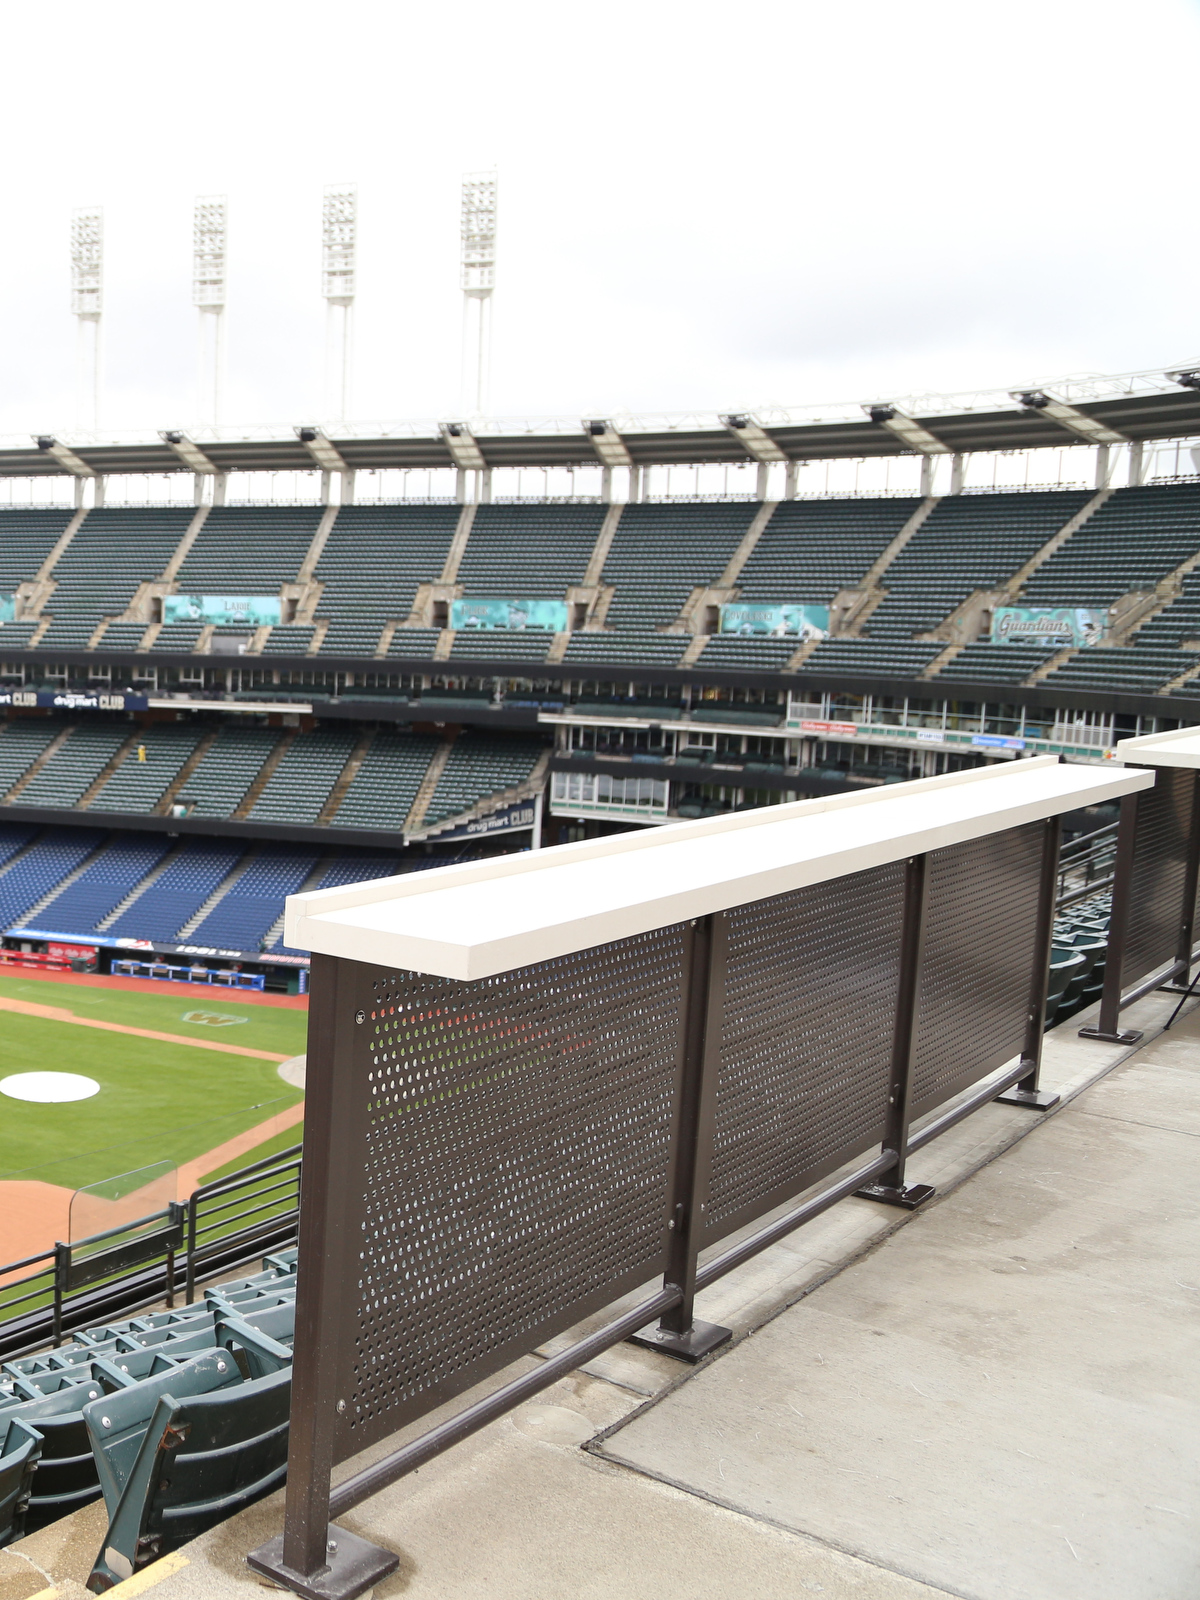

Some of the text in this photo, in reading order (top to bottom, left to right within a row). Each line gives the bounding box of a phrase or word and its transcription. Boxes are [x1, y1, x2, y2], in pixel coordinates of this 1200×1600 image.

[1000, 613, 1072, 636] Guardians
[12, 692, 37, 707] CLUB
[54, 695, 125, 710] drug mart CLUB
[467, 821, 488, 832] drug
[488, 816, 509, 828] mart
[510, 808, 534, 826] CLUB
